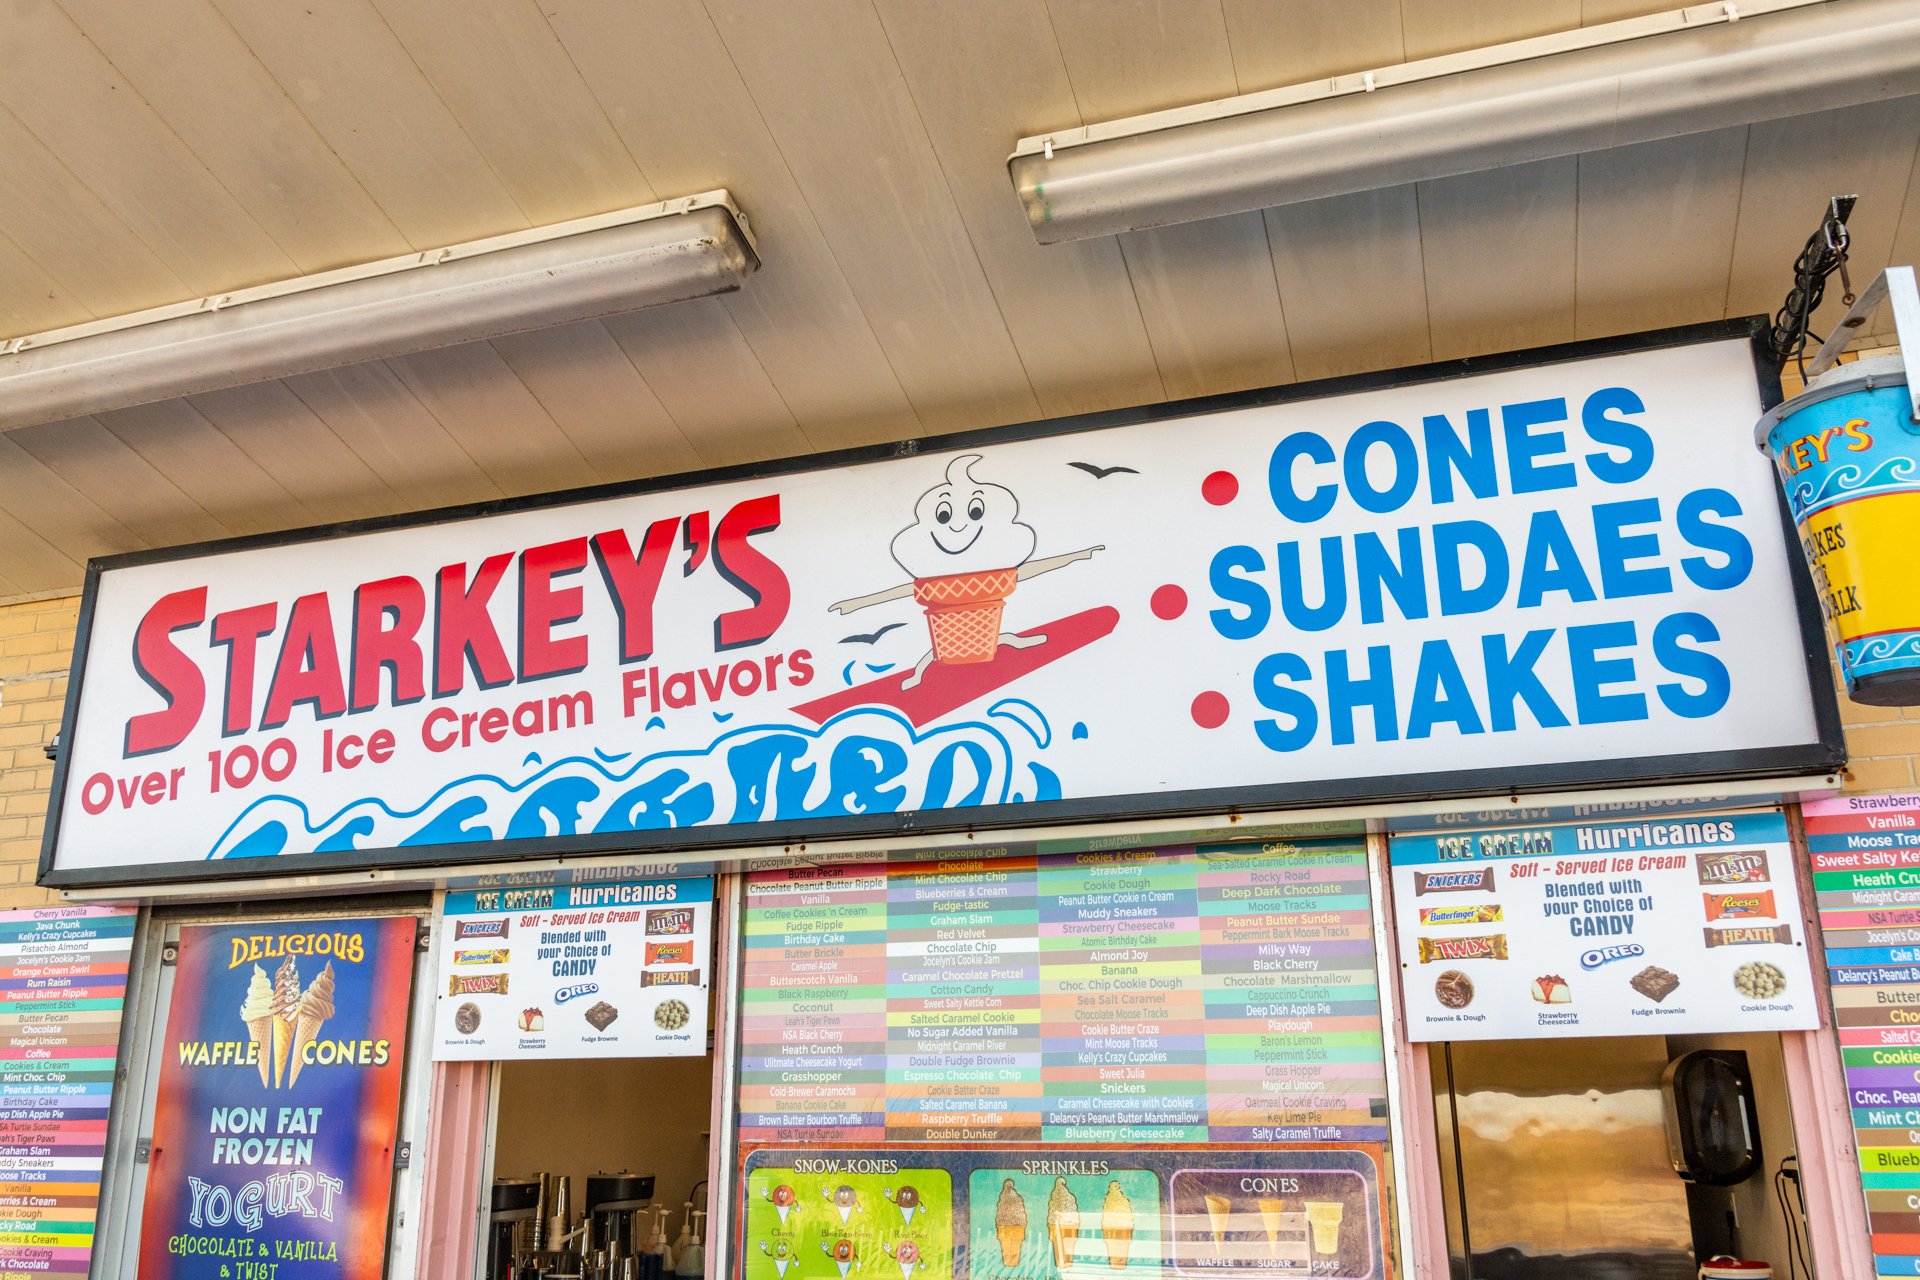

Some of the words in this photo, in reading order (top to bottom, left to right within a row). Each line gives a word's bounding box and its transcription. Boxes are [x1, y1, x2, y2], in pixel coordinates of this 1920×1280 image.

[1269, 387, 1654, 523] CONES
[1209, 488, 1753, 640] SUNDAES
[122, 494, 790, 760] STARKEY'S
[1253, 612, 1731, 752] SHAKES
[82, 766, 185, 815] Over
[209, 738, 297, 793] 100
[323, 729, 395, 773] Ice
[422, 691, 593, 752] Cream
[622, 649, 814, 718] Flavors
[1866, 815, 1915, 829] Vanilla
[1437, 837, 1473, 860] ICE
[1479, 831, 1553, 857] CREAM
[1576, 820, 1736, 851] Hurricanes
[1847, 835, 1893, 848] Moose
[1510, 863, 1538, 878] Soft
[1555, 859, 1607, 876] Served
[1611, 857, 1636, 872] Ice
[1638, 855, 1687, 871] Cream
[1816, 855, 1860, 867] Sweet
[1863, 853, 1897, 866] Salty
[788, 870, 816, 879] Butter
[817, 868, 843, 878] Pecan
[916, 876, 935, 885] Mint
[937, 874, 983, 884] Chocolate
[985, 872, 1007, 883] Chip
[1427, 873, 1482, 887] SNICKERS
[1852, 872, 1896, 887] Heath
[750, 884, 791, 894] Chocolate
[794, 882, 823, 891] Peanut
[826, 881, 852, 890] Butter
[855, 878, 883, 889] Ripple
[1222, 888, 1251, 899] Deep
[1254, 886, 1281, 897] Dark
[1284, 884, 1342, 895] Chocolate
[1545, 880, 1604, 898] Blended
[1610, 879, 1642, 894] with
[475, 891, 500, 912] ICE
[503, 889, 554, 910] CREAM
[569, 883, 677, 906] Hurricanes
[801, 894, 830, 904] Vanilla
[916, 888, 965, 899] Blueberries
[968, 888, 975, 896] &
[977, 887, 1007, 896] Cream
[1543, 902, 1578, 917] your
[1583, 898, 1634, 914] Choice
[1639, 896, 1653, 911] of
[34, 910, 59, 920] Cherry
[61, 908, 87, 917] Vanilla
[520, 914, 539, 928] Soft
[551, 912, 587, 925] Served
[588, 911, 604, 923] Ice
[607, 910, 640, 923] Cream
[1078, 908, 1111, 920] Muddy
[1114, 907, 1157, 917] Sneakers
[1430, 910, 1475, 922] Butterfinger
[36, 922, 52, 931] Java
[55, 920, 80, 930] Chunk
[463, 923, 501, 935] SNICKERS
[1570, 915, 1634, 937] CANDY
[18, 932, 40, 942] Kelly's
[42, 931, 61, 941] Crazy
[63, 930, 96, 940] Cupcakes
[540, 931, 582, 945] Blended
[584, 929, 607, 942] with
[784, 935, 820, 946] Birthday
[823, 934, 845, 943] Cake
[937, 930, 954, 939] Red
[957, 929, 986, 939] Velvet
[1722, 928, 1775, 945] HEATH
[21, 944, 56, 954] Pistachio
[58, 942, 88, 951] Almond
[228, 932, 364, 970] DELICIOUS
[537, 948, 561, 960] your
[563, 945, 599, 957] Choice
[601, 943, 612, 956] of
[1259, 945, 1286, 957] Milky
[1288, 944, 1311, 956] Way
[460, 952, 492, 963] Butterfinger
[1090, 950, 1129, 961] Almond
[1131, 950, 1148, 962] Joy
[1582, 944, 1643, 967] OREO
[552, 959, 596, 977] CANDY
[1253, 960, 1281, 971] Black
[1284, 959, 1318, 970] Cherry
[653, 971, 688, 985] HEATH
[1838, 968, 1878, 983] Delancy's
[1880, 968, 1909, 982] Peanut
[27, 979, 46, 988] Rum
[48, 978, 71, 987] Raisin
[7, 991, 34, 1000] Peanut
[36, 990, 60, 999] Butter
[62, 989, 88, 999] Ripple
[555, 983, 599, 1001] OREO
[1631, 1008, 1654, 1016] Fudge
[1741, 1004, 1767, 1012] Cookie
[1768, 1003, 1794, 1012] Dough
[1455, 1014, 1462, 1022] &
[1463, 1014, 1486, 1022] Dough
[1538, 1012, 1577, 1020] Strawberry
[22, 1025, 62, 1034] Chocolate
[470, 1038, 485, 1046] Dough
[519, 1038, 546, 1046] Strawberry
[25, 1049, 51, 1058] Coffee
[179, 1041, 260, 1066] WAFFLE
[301, 1039, 390, 1066] CONES
[782, 1045, 808, 1055] Heath
[811, 1044, 842, 1054] Crunch
[782, 1072, 842, 1083] Grasshopper
[1100, 1083, 1146, 1093] Snickers
[210, 1107, 267, 1134] NON
[277, 1107, 323, 1134] FAT
[922, 1114, 969, 1126] Raspberry
[971, 1113, 1002, 1123] Truffle
[1869, 1112, 1902, 1126] Mint
[926, 1129, 960, 1139] Double
[962, 1129, 997, 1139] Dunker
[1065, 1127, 1117, 1140] Blueberry
[1119, 1127, 1184, 1138] Cheesecake
[212, 1137, 313, 1165] FROZEN
[1022, 1160, 1109, 1175] SPRINKLES
[1240, 1177, 1299, 1193] CONES
[188, 1170, 343, 1232] YOGURT
[168, 1234, 254, 1257] CHOCOLATE
[258, 1243, 269, 1257] &
[275, 1240, 338, 1262] VANILLA
[1196, 1258, 1234, 1267] WAFFLE
[1257, 1258, 1291, 1268] SUGAR
[1312, 1260, 1339, 1270] CAKE
[219, 1264, 230, 1278] &
[236, 1262, 279, 1280] TWIST
